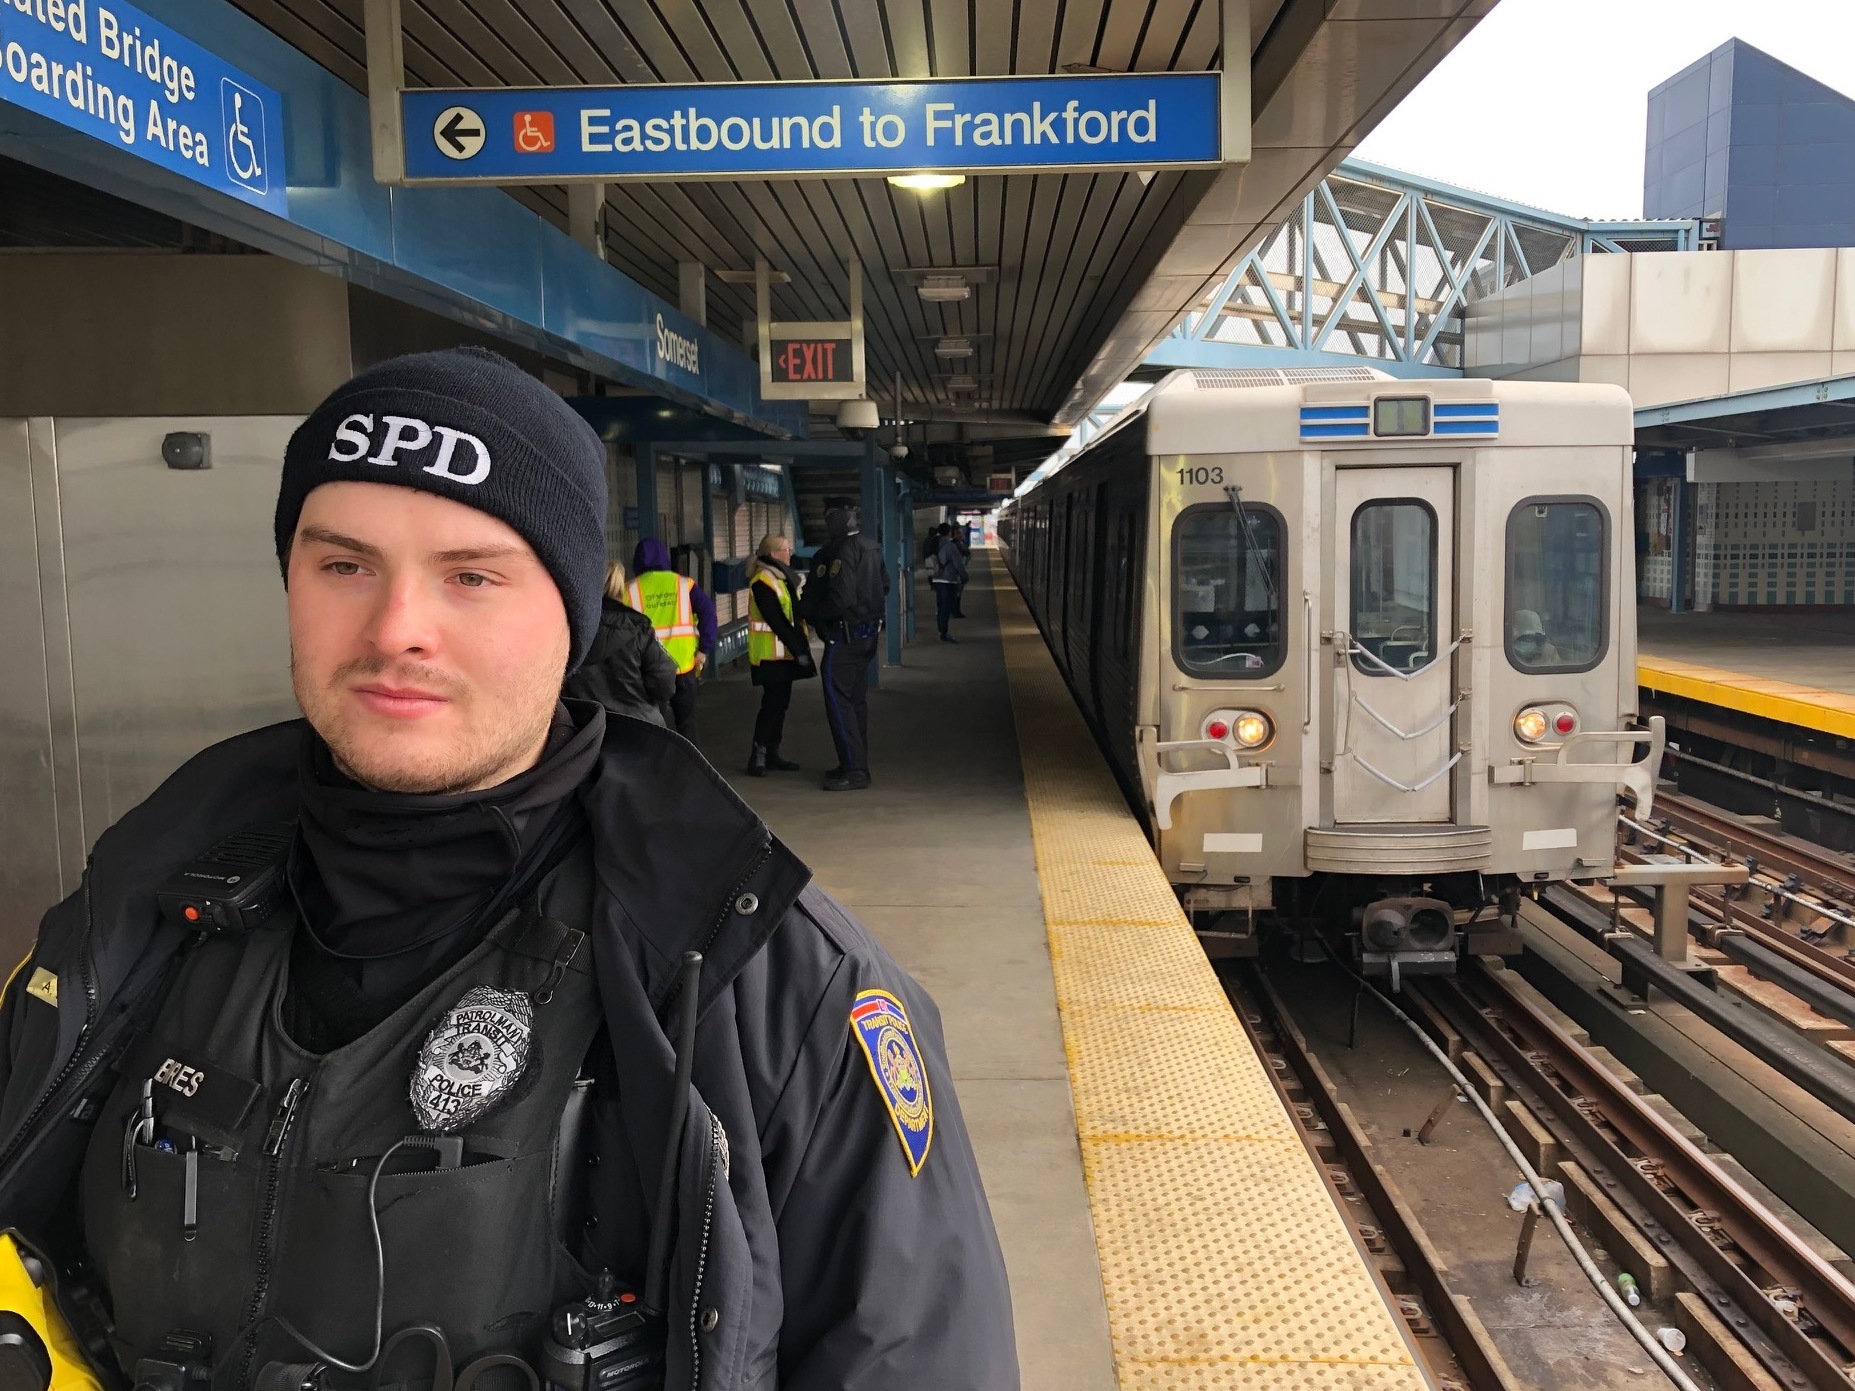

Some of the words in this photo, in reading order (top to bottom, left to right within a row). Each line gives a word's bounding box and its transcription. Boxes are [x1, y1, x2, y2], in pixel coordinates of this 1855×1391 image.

[98, 6, 196, 104] Bridge
[0, 41, 136, 145] oarding
[146, 99, 210, 168] Area
[580, 104, 842, 153] Eastbound
[859, 106, 906, 148] to
[925, 98, 1157, 147] Frankford
[656, 312, 700, 376] Somerset
[787, 342, 837, 380] EXIT
[328, 413, 492, 486] SPD
[1176, 466, 1224, 486] 1103
[456, 1010, 523, 1043] PATROLMAN
[456, 1022, 507, 1048] TRANSIT
[428, 1073, 483, 1098] POLICE
[428, 1093, 461, 1115] 413
